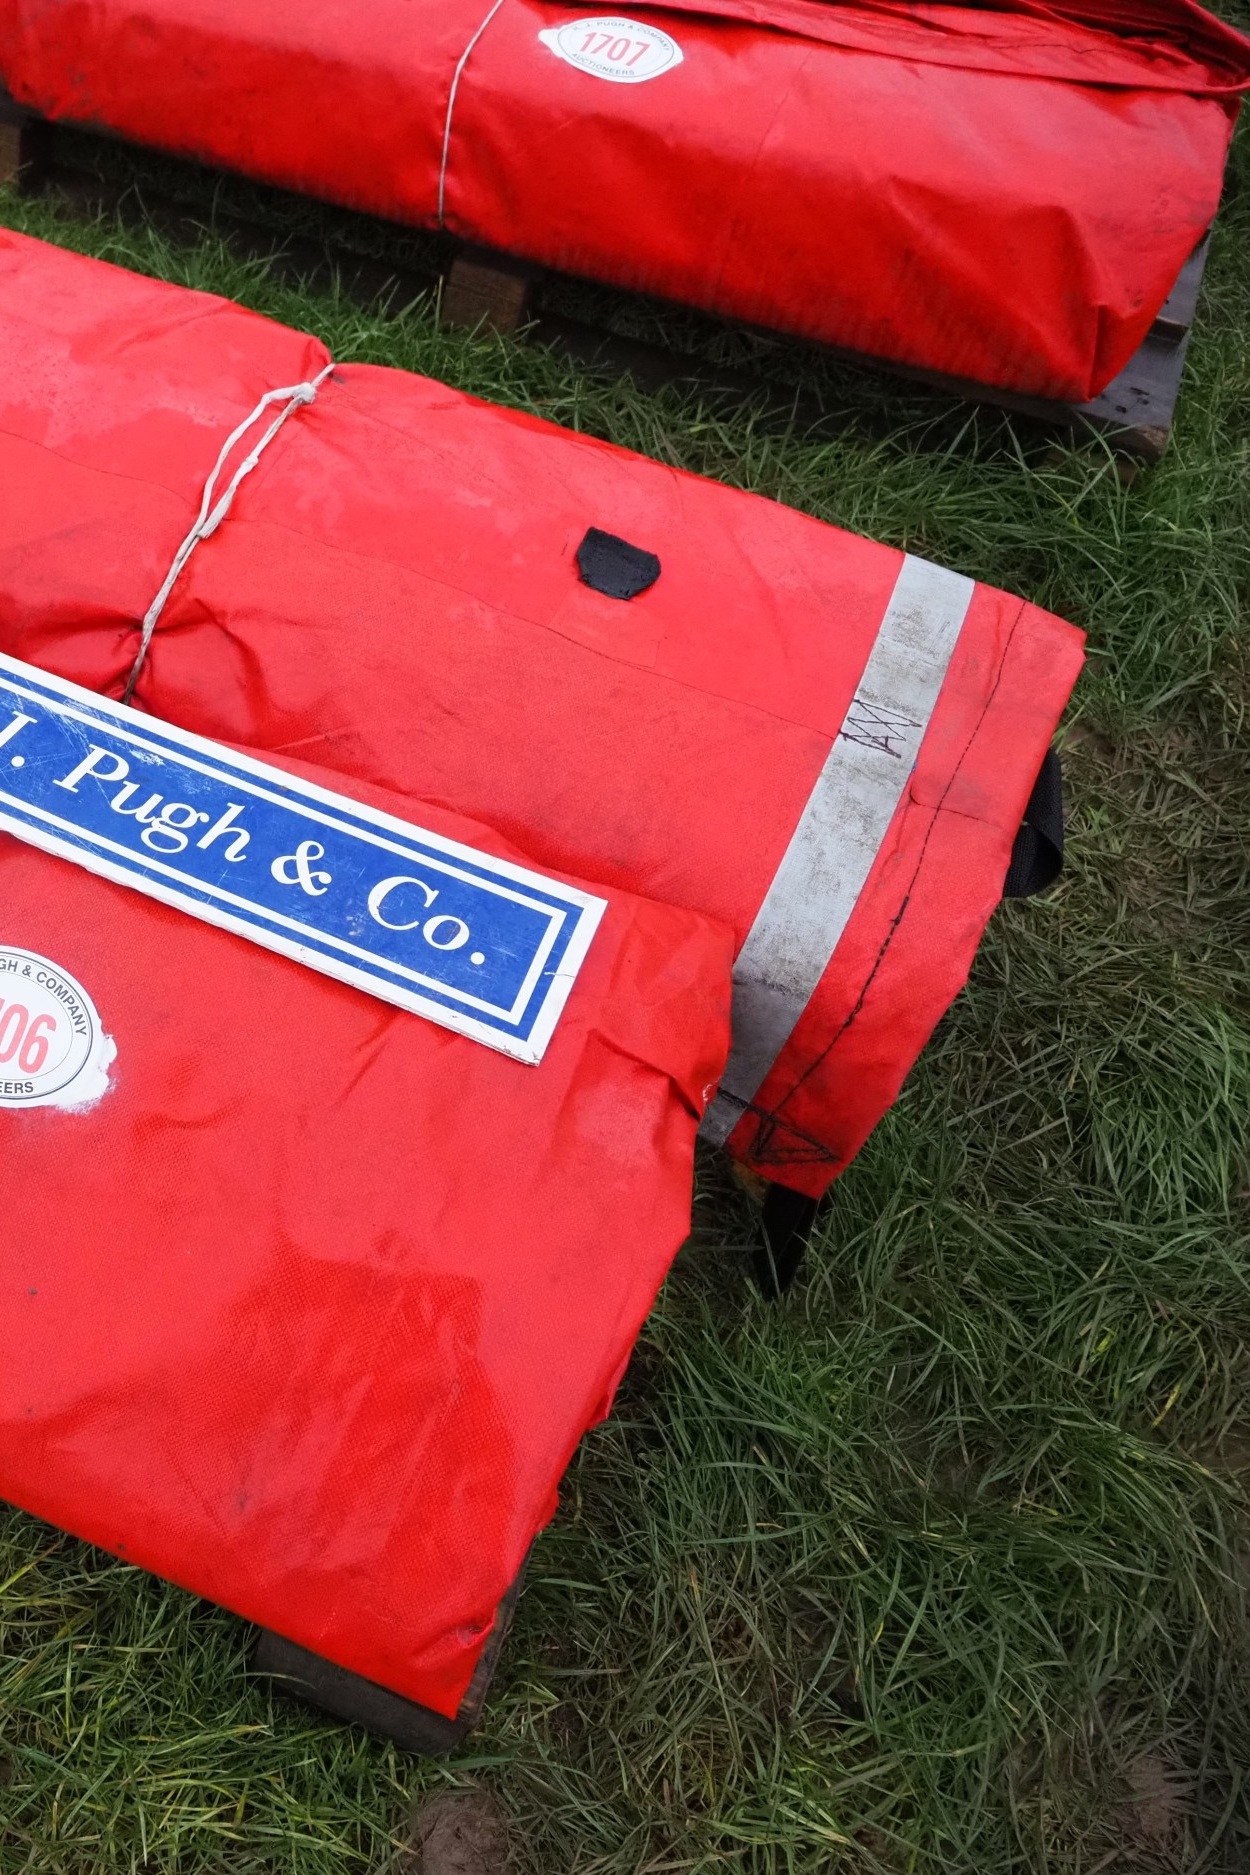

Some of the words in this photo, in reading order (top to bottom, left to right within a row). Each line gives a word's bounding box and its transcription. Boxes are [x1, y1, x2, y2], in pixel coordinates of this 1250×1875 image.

[571, 53, 635, 76] AUCTIONEERS
[579, 31, 652, 67] 1707
[52, 742, 249, 863] Pugh
[270, 840, 333, 897] &
[366, 874, 487, 967] Co.
[21, 964, 32, 978] &
[36, 971, 88, 1036] COMPANY
